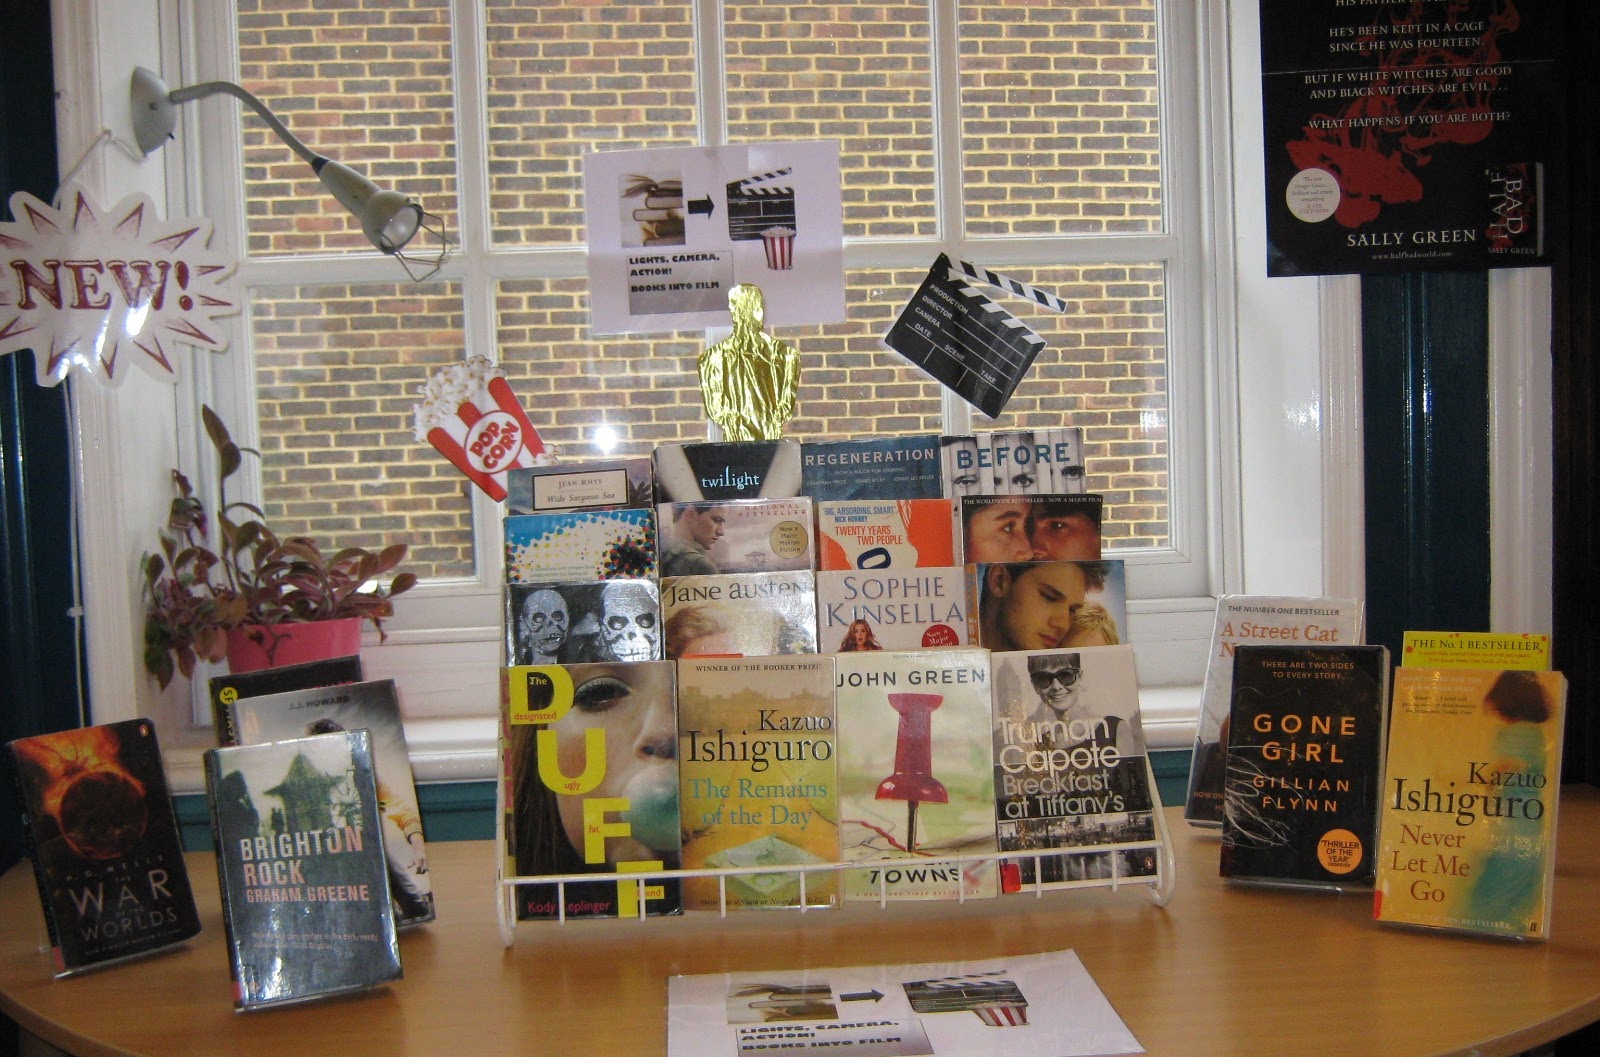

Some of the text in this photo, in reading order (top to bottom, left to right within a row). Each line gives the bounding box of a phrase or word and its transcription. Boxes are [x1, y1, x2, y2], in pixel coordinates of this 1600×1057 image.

[1329, 21, 1485, 37] HE'S BEEN KEPT IN A CAGE
[1329, 37, 1485, 53] SINCE HE WAS FOURTEEN.
[1304, 66, 1512, 84] BUT IF WHITE WITCHES ARE GOOD
[1310, 89, 1336, 99] AND
[1340, 87, 1375, 98] BLACK
[1378, 84, 1434, 95] WITCHES
[1437, 83, 1458, 93] ARE
[1308, 111, 1511, 129] WHAT HAPPENS IF YOU ARE BOTH?
[1506, 179, 1523, 234] BAD
[1347, 229, 1477, 247] SALLY GREEN
[629, 253, 720, 265] LIGHTS, CAMERA,
[1371, 250, 1453, 260] www.halfbadworld.com
[1510, 247, 1535, 255] GREEN
[630, 268, 672, 276] ACTION!
[10, 259, 194, 311] NEW!
[631, 281, 719, 292] BOOKS INTO FILM
[922, 295, 953, 320] DIRECTOR
[929, 284, 969, 315] PRODUCTION
[914, 307, 941, 328] CAMERA
[914, 323, 997, 385] DATE SCENE TAKE
[469, 421, 500, 457] POP
[483, 420, 520, 470] CORN
[805, 448, 934, 466] REGENERATION
[956, 442, 1072, 470] BEFORE
[558, 478, 604, 490] JEAN RHYS
[702, 465, 760, 491] twilight
[547, 491, 616, 505] Wide Sargasso Sea
[837, 506, 873, 515] ABSORBING,
[835, 525, 891, 536] TWENTY YEARS
[857, 535, 903, 545] TWO PEOPLE
[843, 575, 946, 601] SOPHIE
[826, 602, 965, 628] KINSELLA
[1243, 606, 1276, 614] NUMBER
[1295, 608, 1340, 616] BESTSELLER
[1220, 622, 1339, 641] A Street Cat
[1411, 639, 1542, 651] THE No. 1 BESTSELLER
[1286, 671, 1311, 679] EVERY
[1290, 661, 1306, 669] ARE
[1330, 662, 1354, 670] SIDES
[529, 676, 547, 686] The
[837, 668, 985, 687] JOHN GREEN
[306, 695, 349, 708] HOWARD
[509, 665, 575, 725] D
[514, 711, 557, 721] designated
[758, 710, 832, 731] Kazuo
[1253, 713, 1356, 736] GONE
[999, 717, 1110, 745] Truman
[686, 729, 832, 772] Ishiguro
[1262, 741, 1344, 764] GIRL
[537, 728, 606, 795] U
[1000, 744, 1120, 777] Capote
[1003, 769, 1110, 796] Breakfast
[1253, 775, 1350, 793] GILLIAN
[1467, 761, 1547, 789] Kazuo
[564, 781, 581, 791] ugly
[688, 778, 828, 800] The Remains
[1005, 791, 1125, 819] at Tiffany's
[1262, 796, 1338, 812] FLYNN
[1391, 778, 1545, 826] Ishiguro
[702, 804, 813, 830] of the Day
[583, 797, 631, 864] F
[588, 825, 600, 834] fat
[1400, 824, 1466, 848] Never
[240, 825, 363, 860] BRIGHTON
[107, 855, 163, 872] WELLS
[243, 860, 305, 886] ROCK
[1391, 851, 1470, 878] Let Me
[870, 868, 959, 884] TOWNS
[68, 869, 172, 916] WAR
[246, 884, 369, 903] GRAHAM GREENE
[616, 861, 665, 918] F
[1410, 880, 1445, 903] Go
[528, 900, 611, 914] Kody eplinger
[82, 907, 177, 941] WORLDS
[740, 1021, 899, 1033] LIGHTS, CAMERA,
[741, 1032, 815, 1041] ACTION!
[742, 1042, 805, 1051] BOOKS
